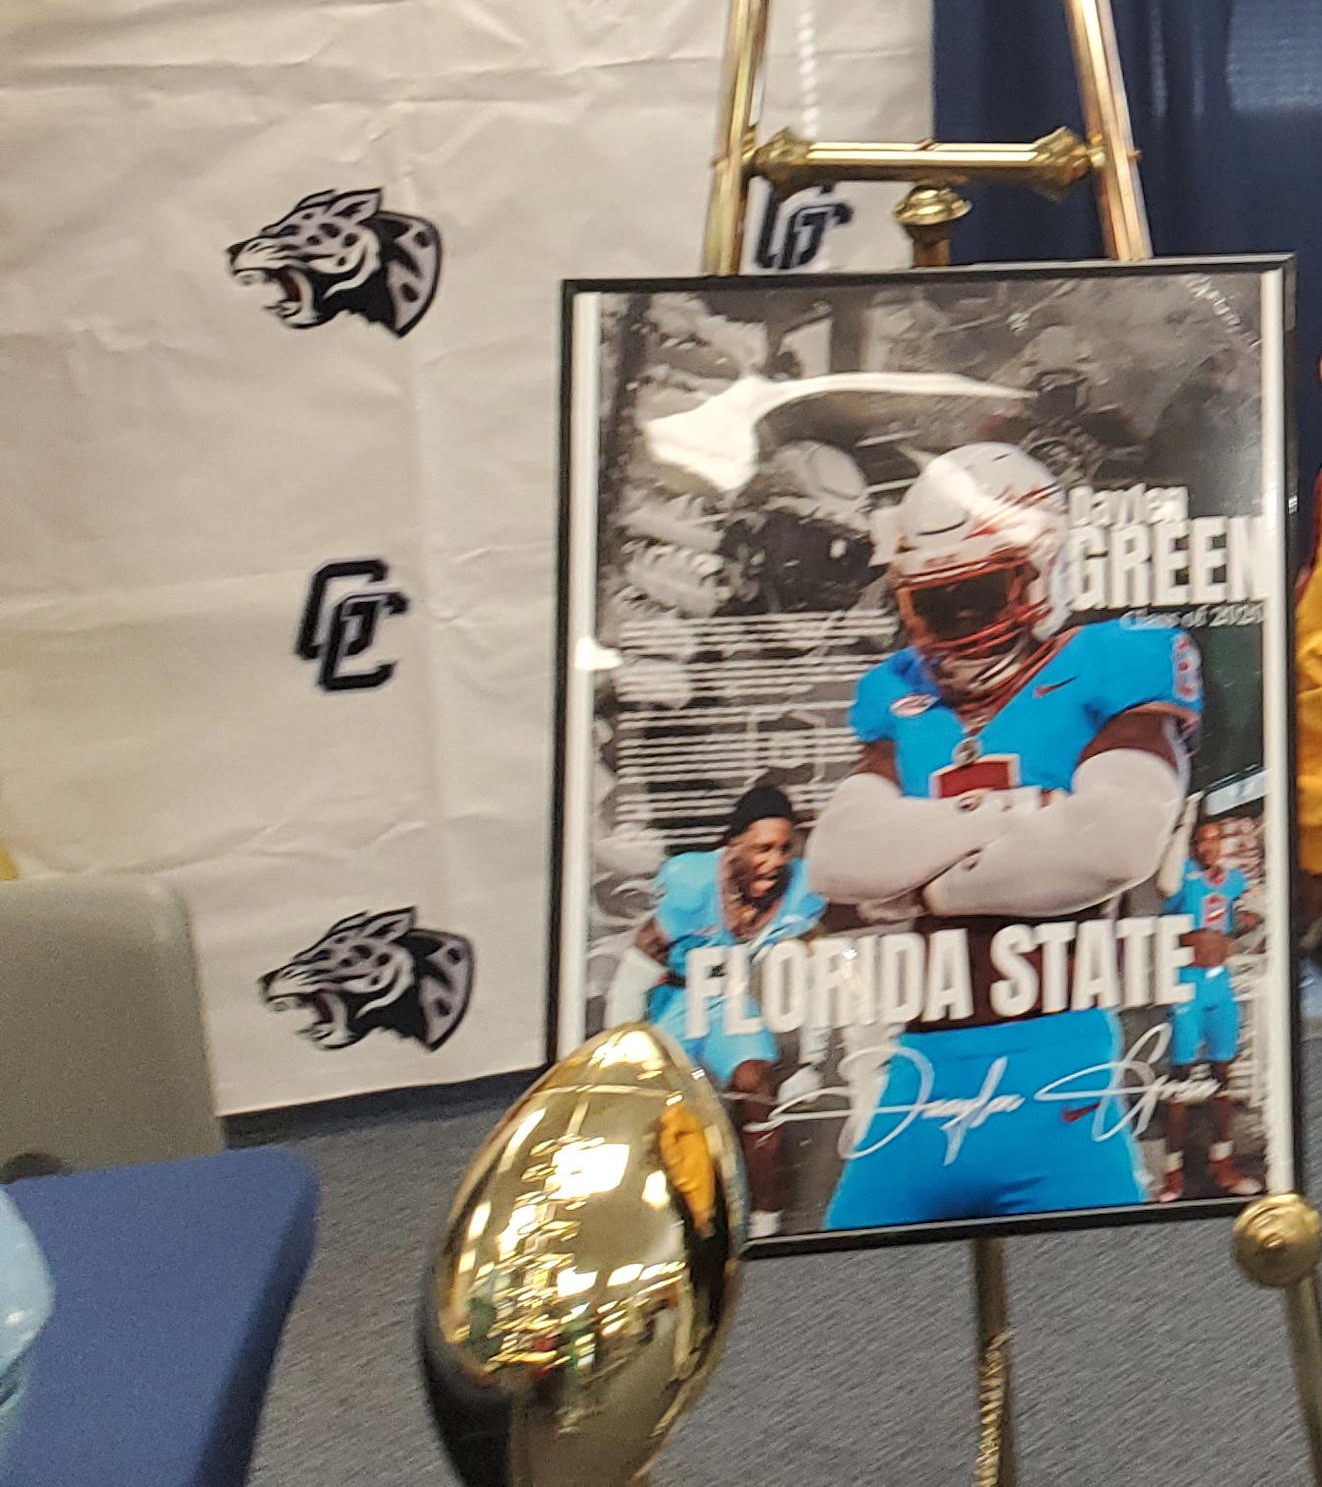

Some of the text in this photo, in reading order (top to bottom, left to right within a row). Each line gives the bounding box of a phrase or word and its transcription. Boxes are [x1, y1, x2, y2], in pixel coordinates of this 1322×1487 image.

[1068, 515, 1264, 611] GREEN
[685, 913, 1198, 1039] FLORIDA STATE
